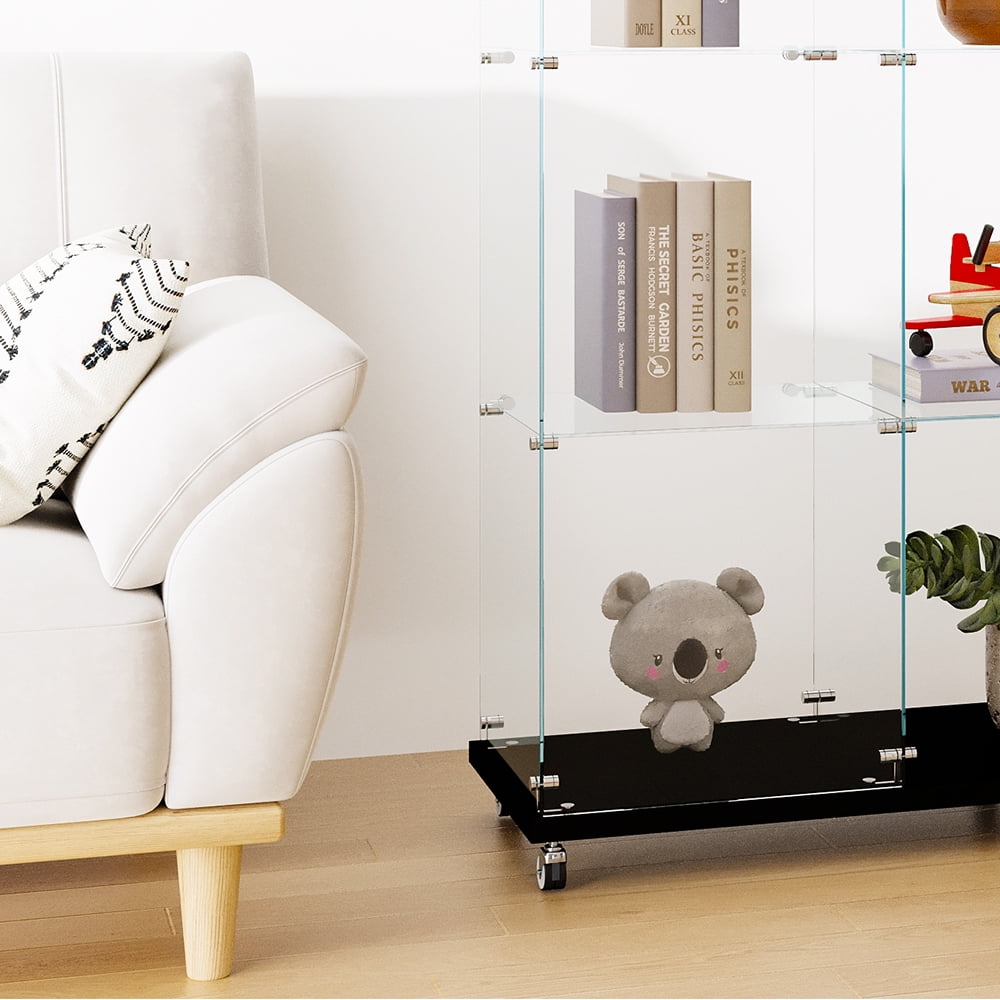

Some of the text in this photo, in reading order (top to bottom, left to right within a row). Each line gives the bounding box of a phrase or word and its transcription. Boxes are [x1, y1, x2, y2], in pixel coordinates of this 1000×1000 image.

[676, 15, 691, 26] XI
[617, 222, 625, 332] SON of SERGE BASTARDE
[659, 225, 670, 352] THE SECRET GARDEN
[691, 233, 704, 361] BASIC PHISICS
[727, 248, 739, 330] PHISICS
[730, 371, 744, 379] XII
[951, 379, 991, 393] WAR
